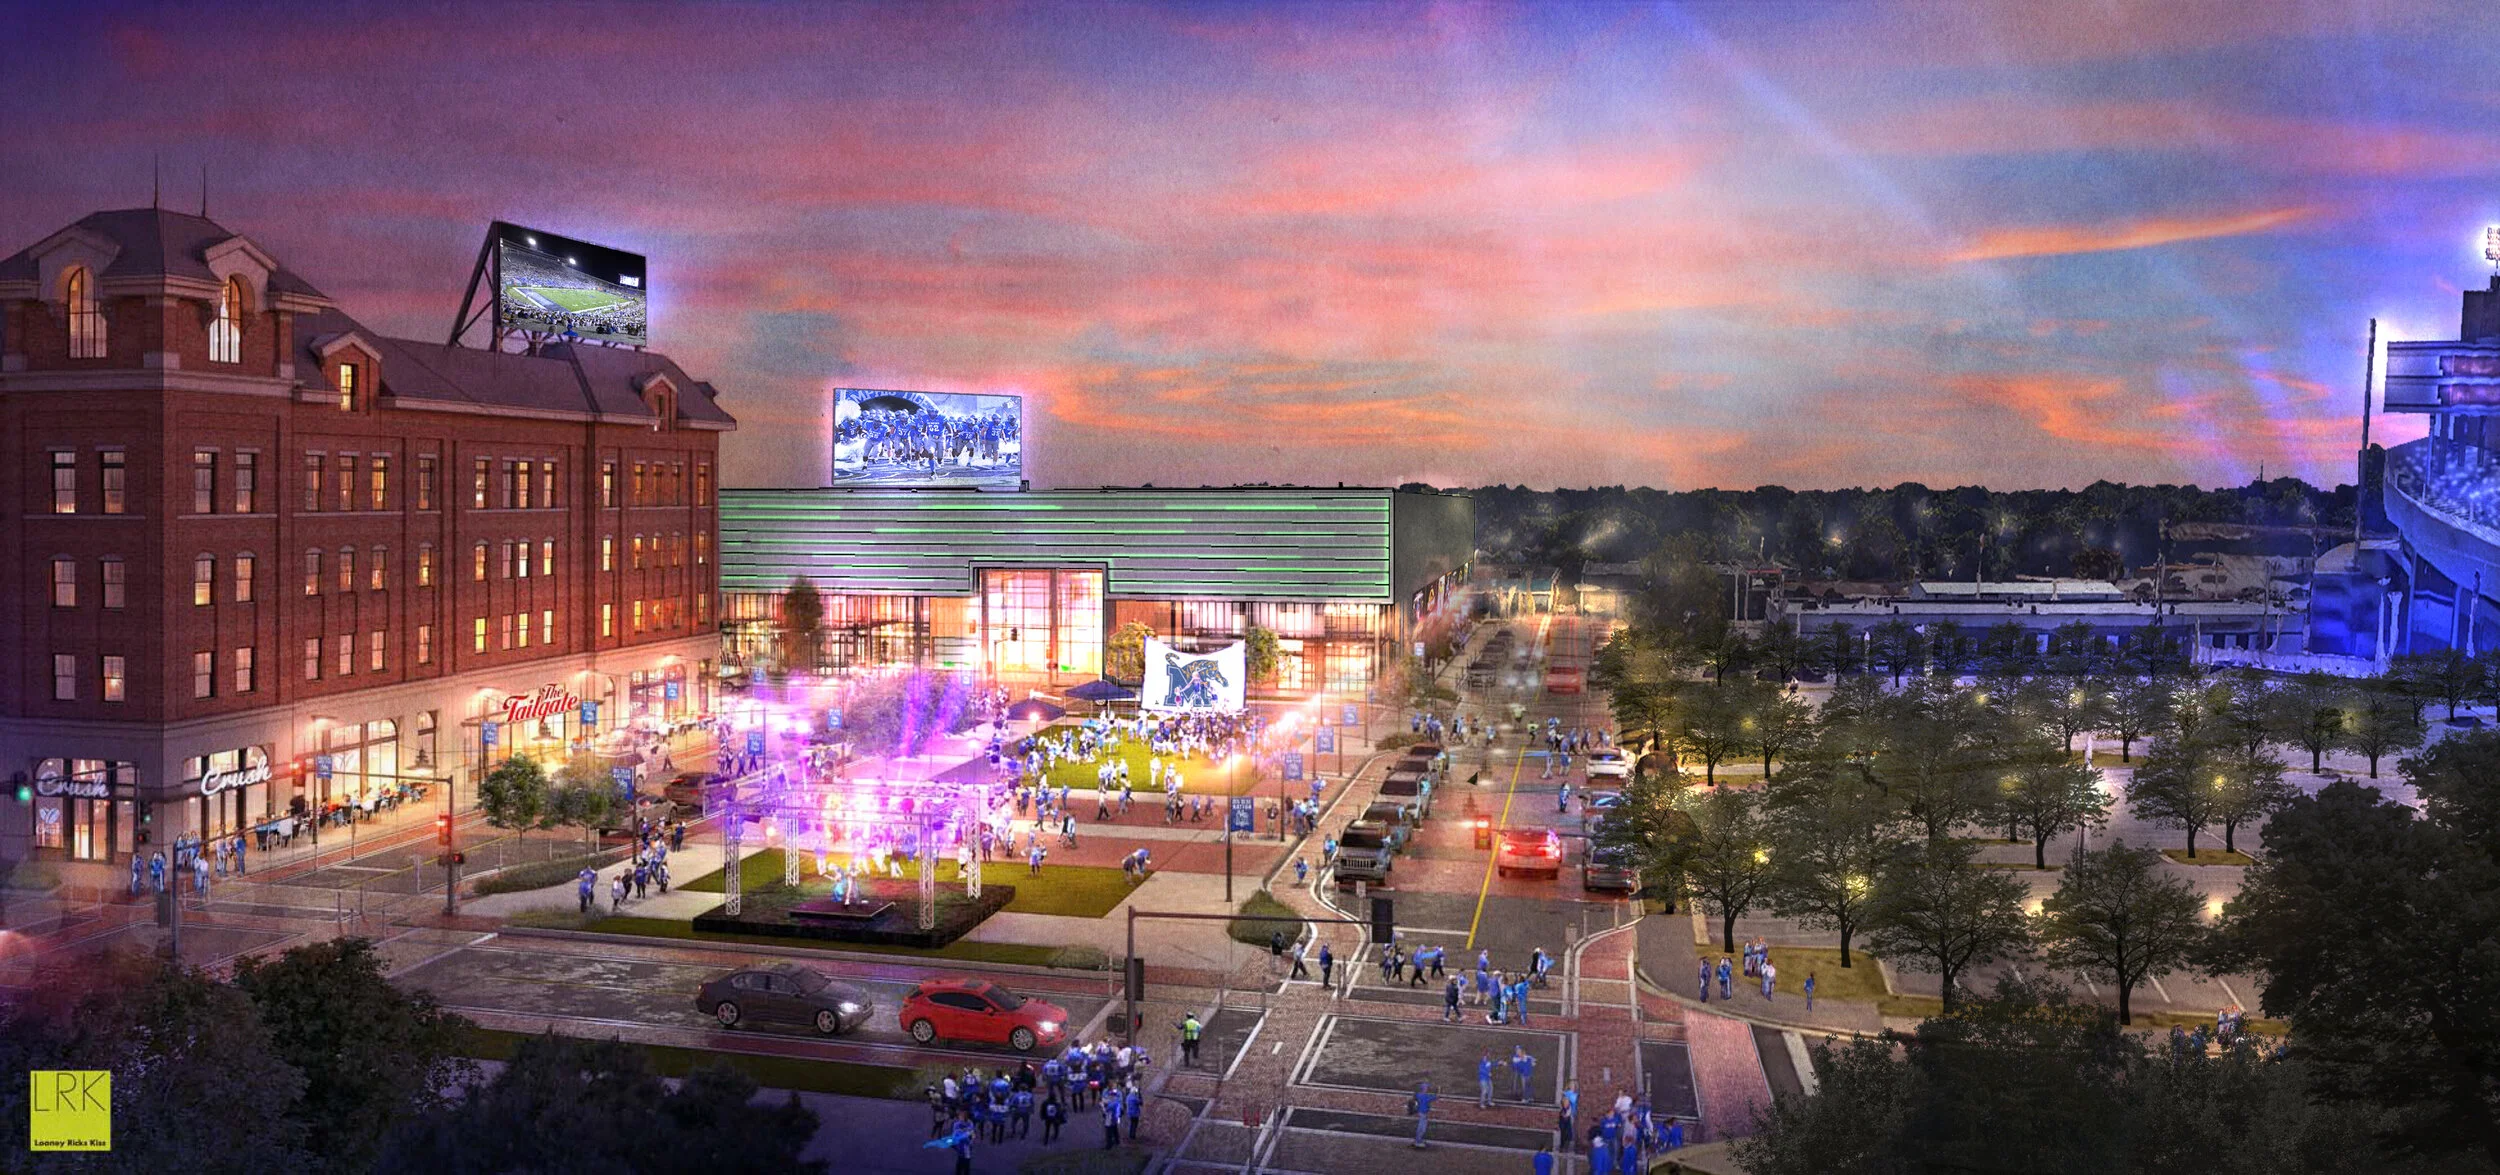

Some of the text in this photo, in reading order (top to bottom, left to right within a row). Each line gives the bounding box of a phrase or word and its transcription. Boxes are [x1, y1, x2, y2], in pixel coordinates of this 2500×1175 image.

[541, 683, 564, 700] The
[502, 691, 578, 724] Tailgate
[37, 770, 110, 798] Crush
[200, 754, 272, 796] Crush
